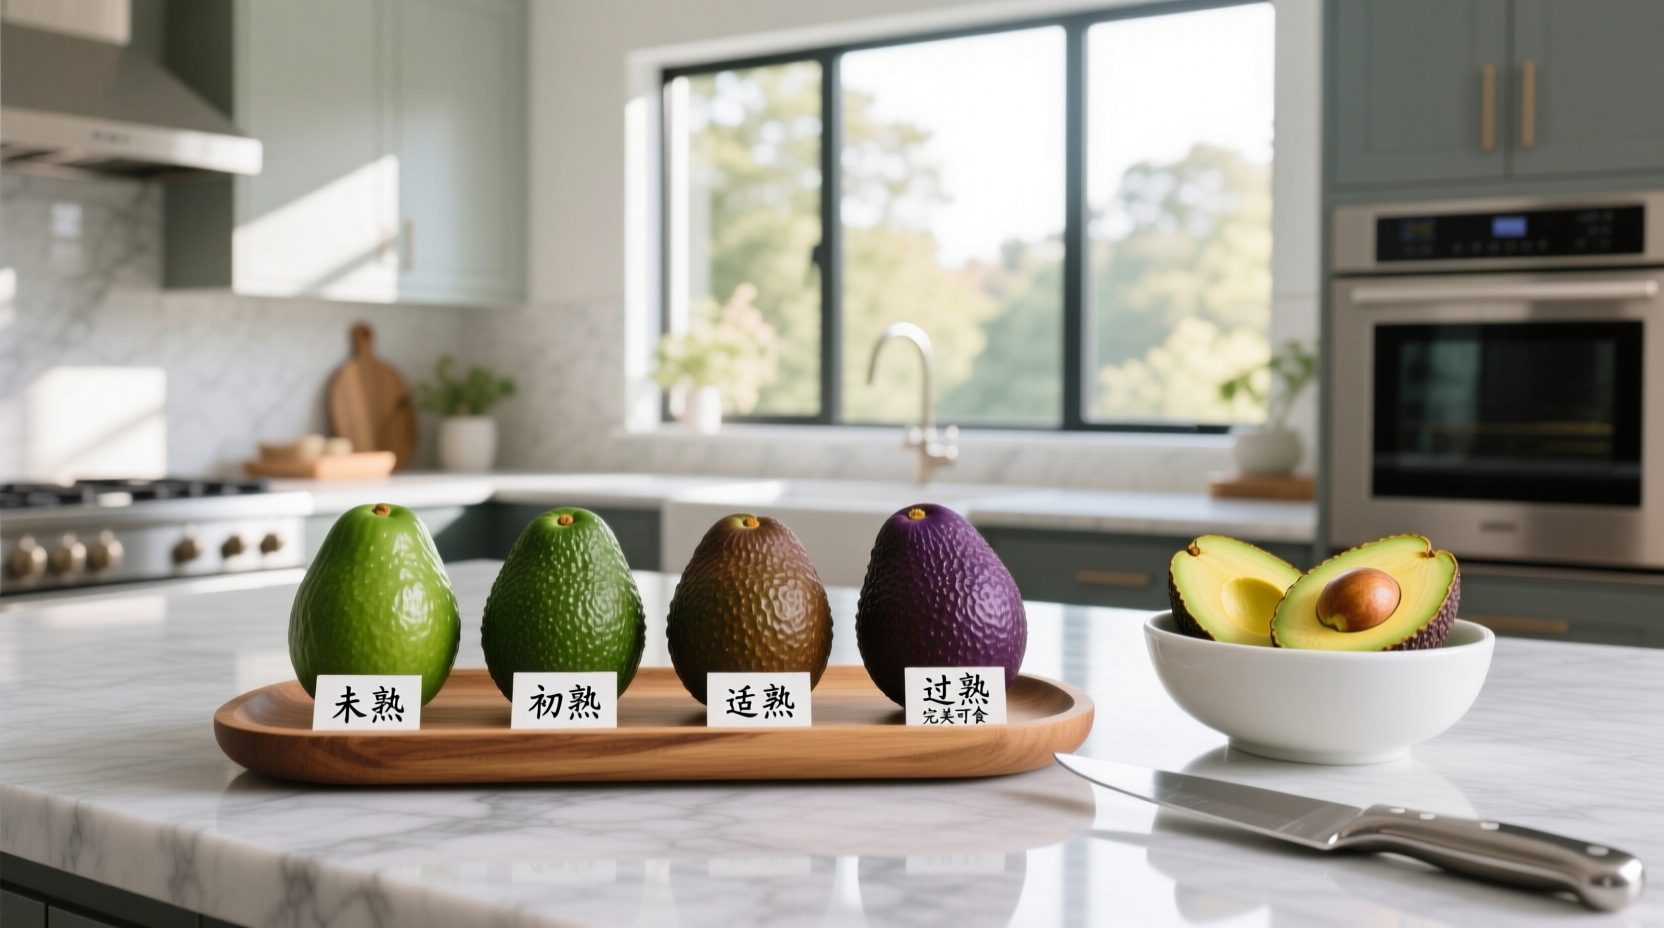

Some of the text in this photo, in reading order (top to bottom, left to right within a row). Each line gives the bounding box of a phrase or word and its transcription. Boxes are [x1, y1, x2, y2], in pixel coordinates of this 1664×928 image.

[332, 685, 405, 724] 未熟
[528, 683, 601, 721] 初熟
[725, 683, 795, 720] 适熟
[922, 672, 990, 705] 过熟
[922, 706, 989, 724] 完美可食
